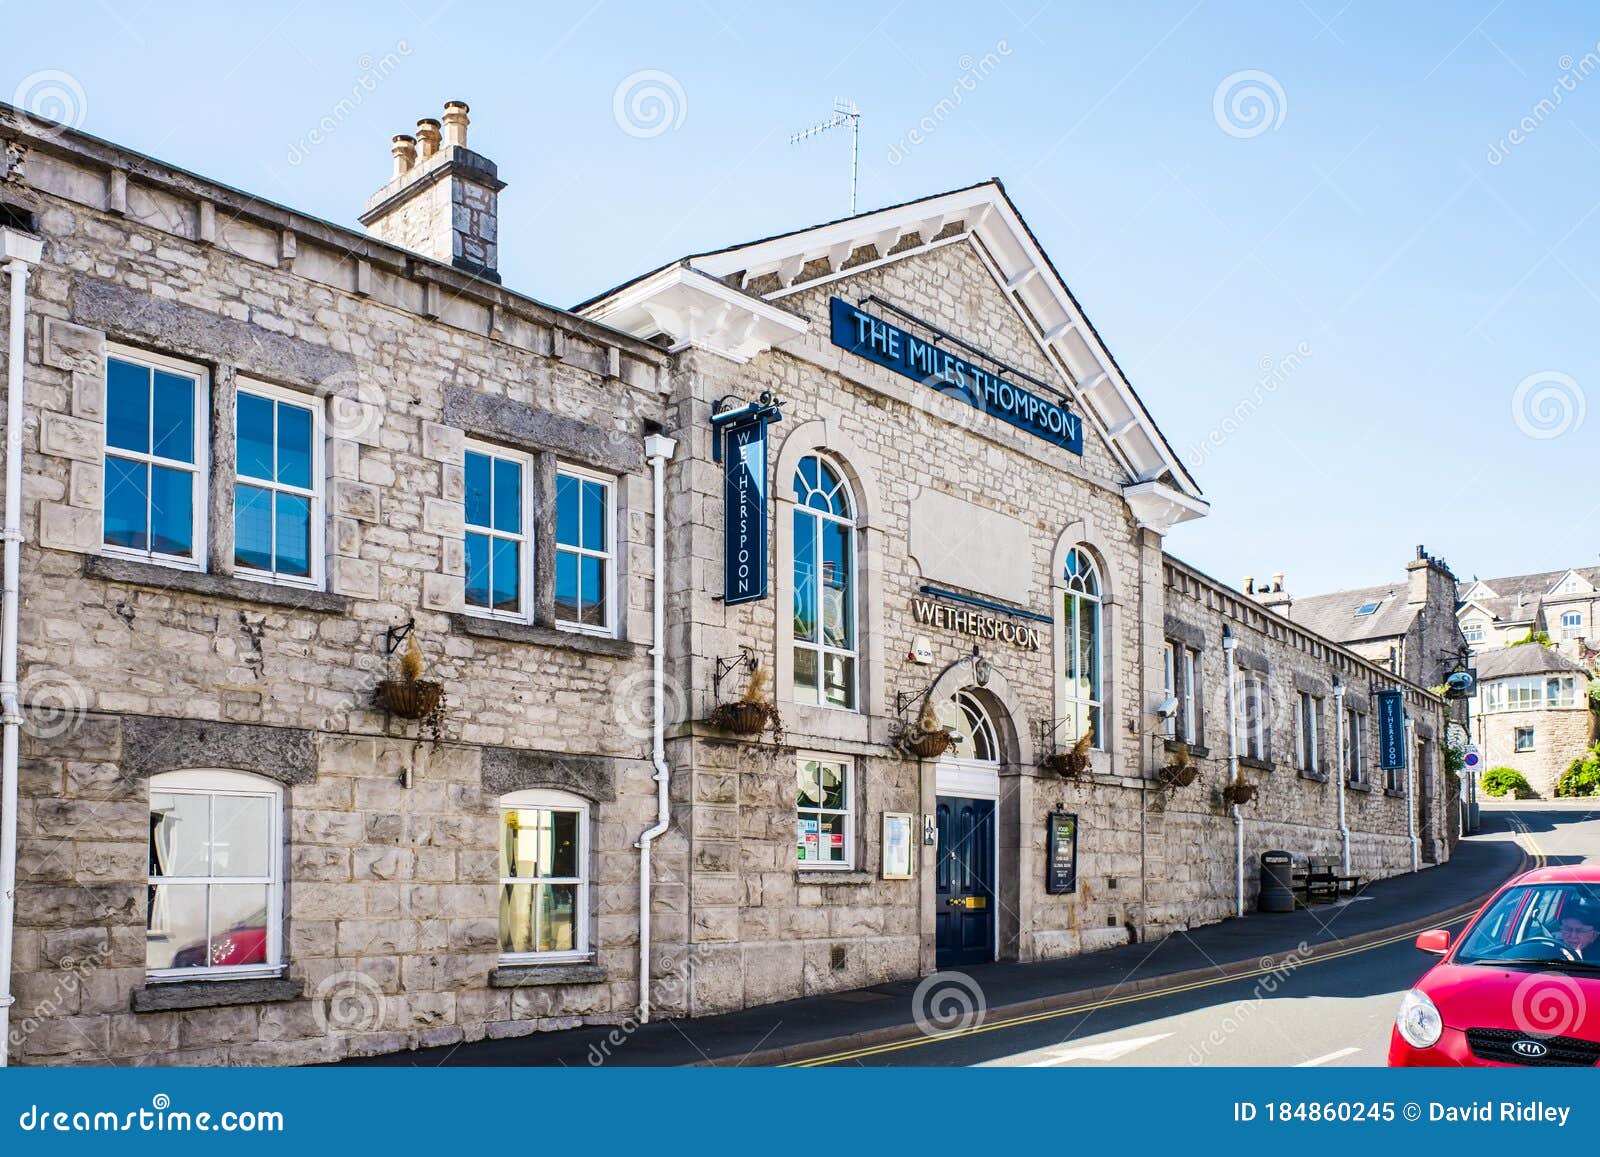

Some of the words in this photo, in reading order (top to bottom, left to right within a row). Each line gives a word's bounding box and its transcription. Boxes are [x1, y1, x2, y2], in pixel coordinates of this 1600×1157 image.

[854, 311, 899, 358] THE
[910, 338, 965, 388] MILES
[971, 368, 1075, 441] THOMPSON
[737, 431, 750, 593] WETHERSPOON
[914, 599, 1040, 650] WETHERSPOON
[1385, 699, 1396, 766] WETHERSPOON
[1517, 1042, 1542, 1055] KIA
